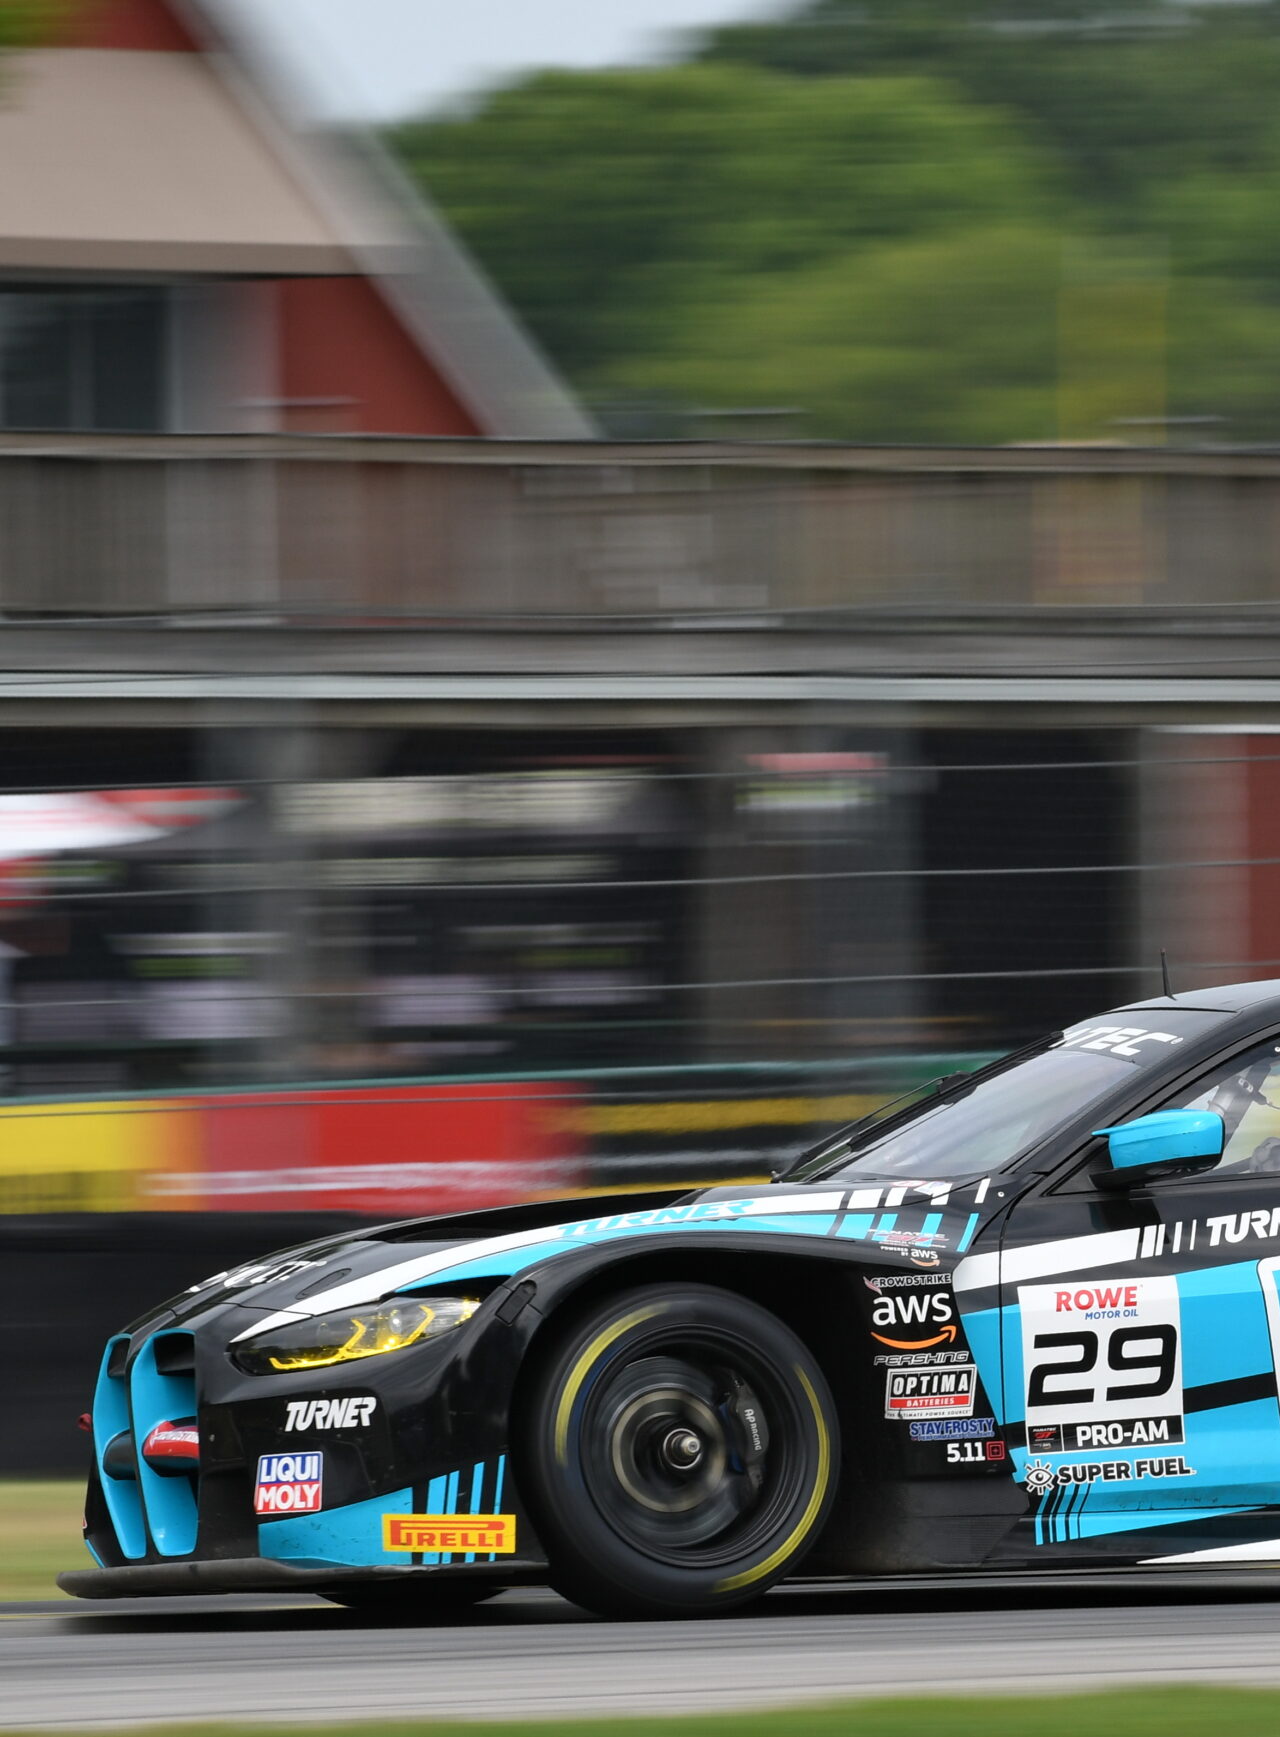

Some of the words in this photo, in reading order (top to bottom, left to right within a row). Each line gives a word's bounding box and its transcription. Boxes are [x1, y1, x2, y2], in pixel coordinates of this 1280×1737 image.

[911, 1248, 939, 1260] aws
[871, 1273, 952, 1288] CROWDSTRIKE
[872, 1292, 952, 1326] aws
[1055, 1286, 1137, 1312] ROWE
[1085, 1311, 1120, 1320] MOTOR
[1122, 1309, 1138, 1317] OIL
[873, 1351, 970, 1366] PERSHING
[1027, 1324, 1177, 1407] 29
[892, 1373, 969, 1396] OPTIMA
[285, 1397, 377, 1432] TURNER
[906, 1397, 955, 1408] BATTERIES
[910, 1421, 943, 1437] STAY
[944, 1418, 995, 1435] FROSTY
[1076, 1420, 1169, 1447] PRO-AM
[947, 1441, 985, 1462] 5.11
[260, 1455, 319, 1482] LIQUI
[1058, 1462, 1131, 1484] SUPER
[1135, 1457, 1194, 1478] FUEL
[257, 1484, 320, 1510] MOLY
[390, 1520, 505, 1547] PIRELLI
